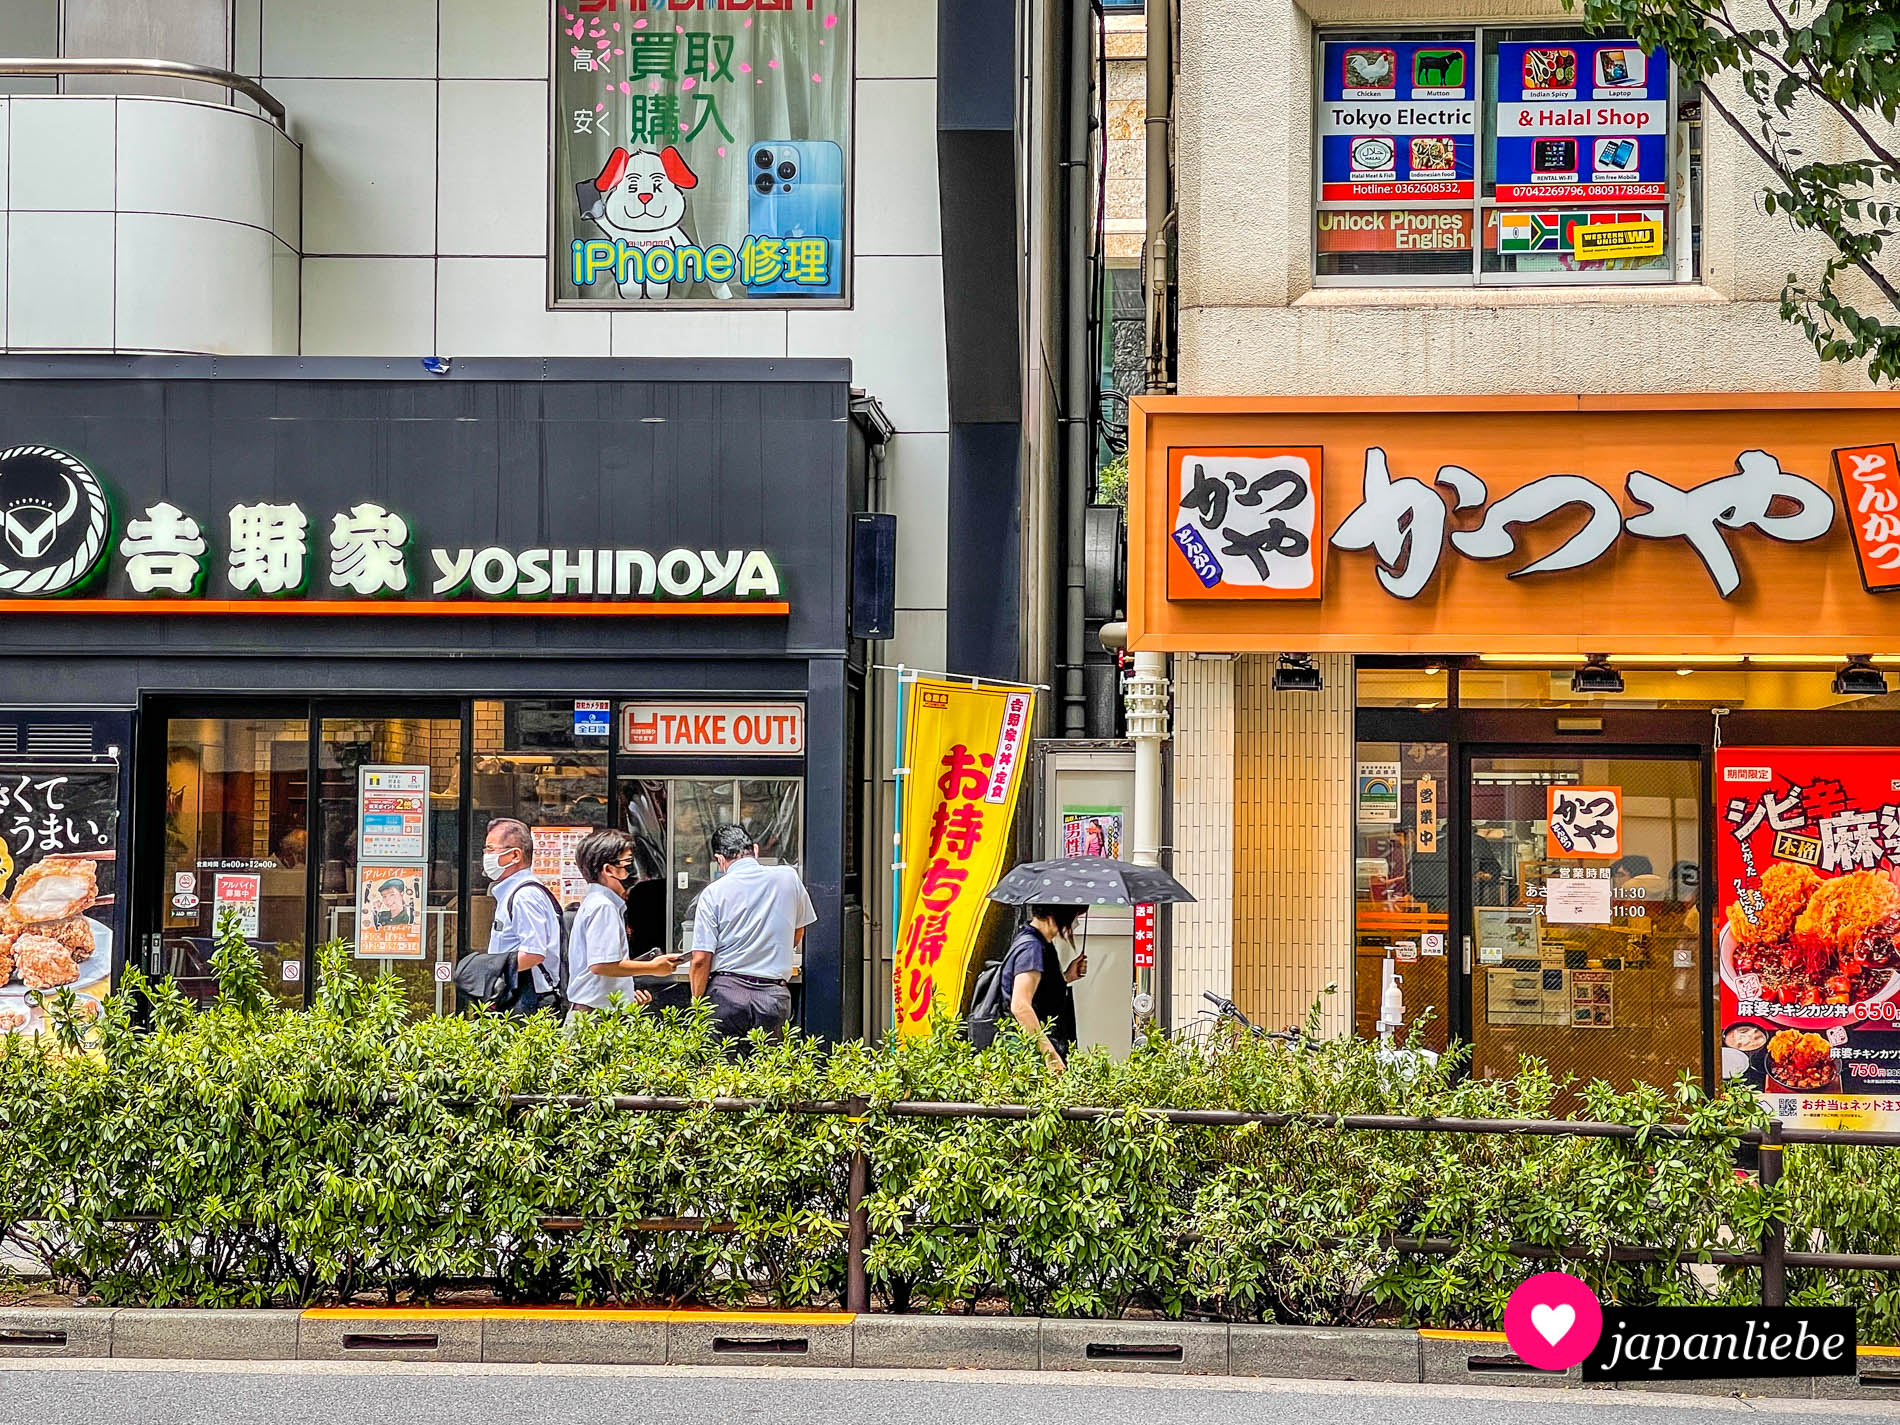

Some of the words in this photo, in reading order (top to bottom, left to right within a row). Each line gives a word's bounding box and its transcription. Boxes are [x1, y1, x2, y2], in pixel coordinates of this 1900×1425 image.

[573, 48, 611, 73] 高く
[629, 32, 734, 83] 買取
[1551, 91, 1569, 99] Spicy
[1609, 90, 1632, 98] Laptop
[573, 109, 610, 136] 安く
[630, 93, 735, 144] 購入
[1332, 109, 1392, 129] Tokyo
[1397, 108, 1472, 125] Electric
[1518, 110, 1534, 126] &
[1539, 109, 1591, 126] Halal
[1597, 108, 1650, 129] Shop
[1353, 184, 1393, 194] Hotline:
[1513, 186, 1586, 197] 07042269796,
[1588, 185, 1659, 196] 08091789649
[1318, 211, 1385, 230] Unlock
[1390, 211, 1463, 230] Phones
[1396, 229, 1466, 249] English
[1584, 231, 1624, 240] WESTERN
[1597, 237, 1624, 245] UNION
[1848, 453, 1900, 571] とんかつ
[1329, 446, 1835, 600] かつや
[120, 502, 408, 594] 吉野家
[431, 546, 780, 596] YOSHINOYA
[660, 715, 726, 744] TAKE
[733, 714, 797, 745] OUT!
[1727, 769, 1769, 780] 期間限定
[1420, 788, 1433, 846] 営業中
[9, 813, 109, 855] うまい。
[1065, 823, 1081, 857] 男性
[1780, 836, 1817, 860] 本格
[905, 743, 995, 1022] お持ち帰り
[1559, 868, 1611, 879] 営業時間
[1136, 905, 1146, 964] 送水口
[1737, 1001, 1849, 1018] 麻婆チキンカツ丼
[1830, 1047, 1900, 1060] 麻婆チキンカツ
[1849, 1063, 1887, 1077] 750円
